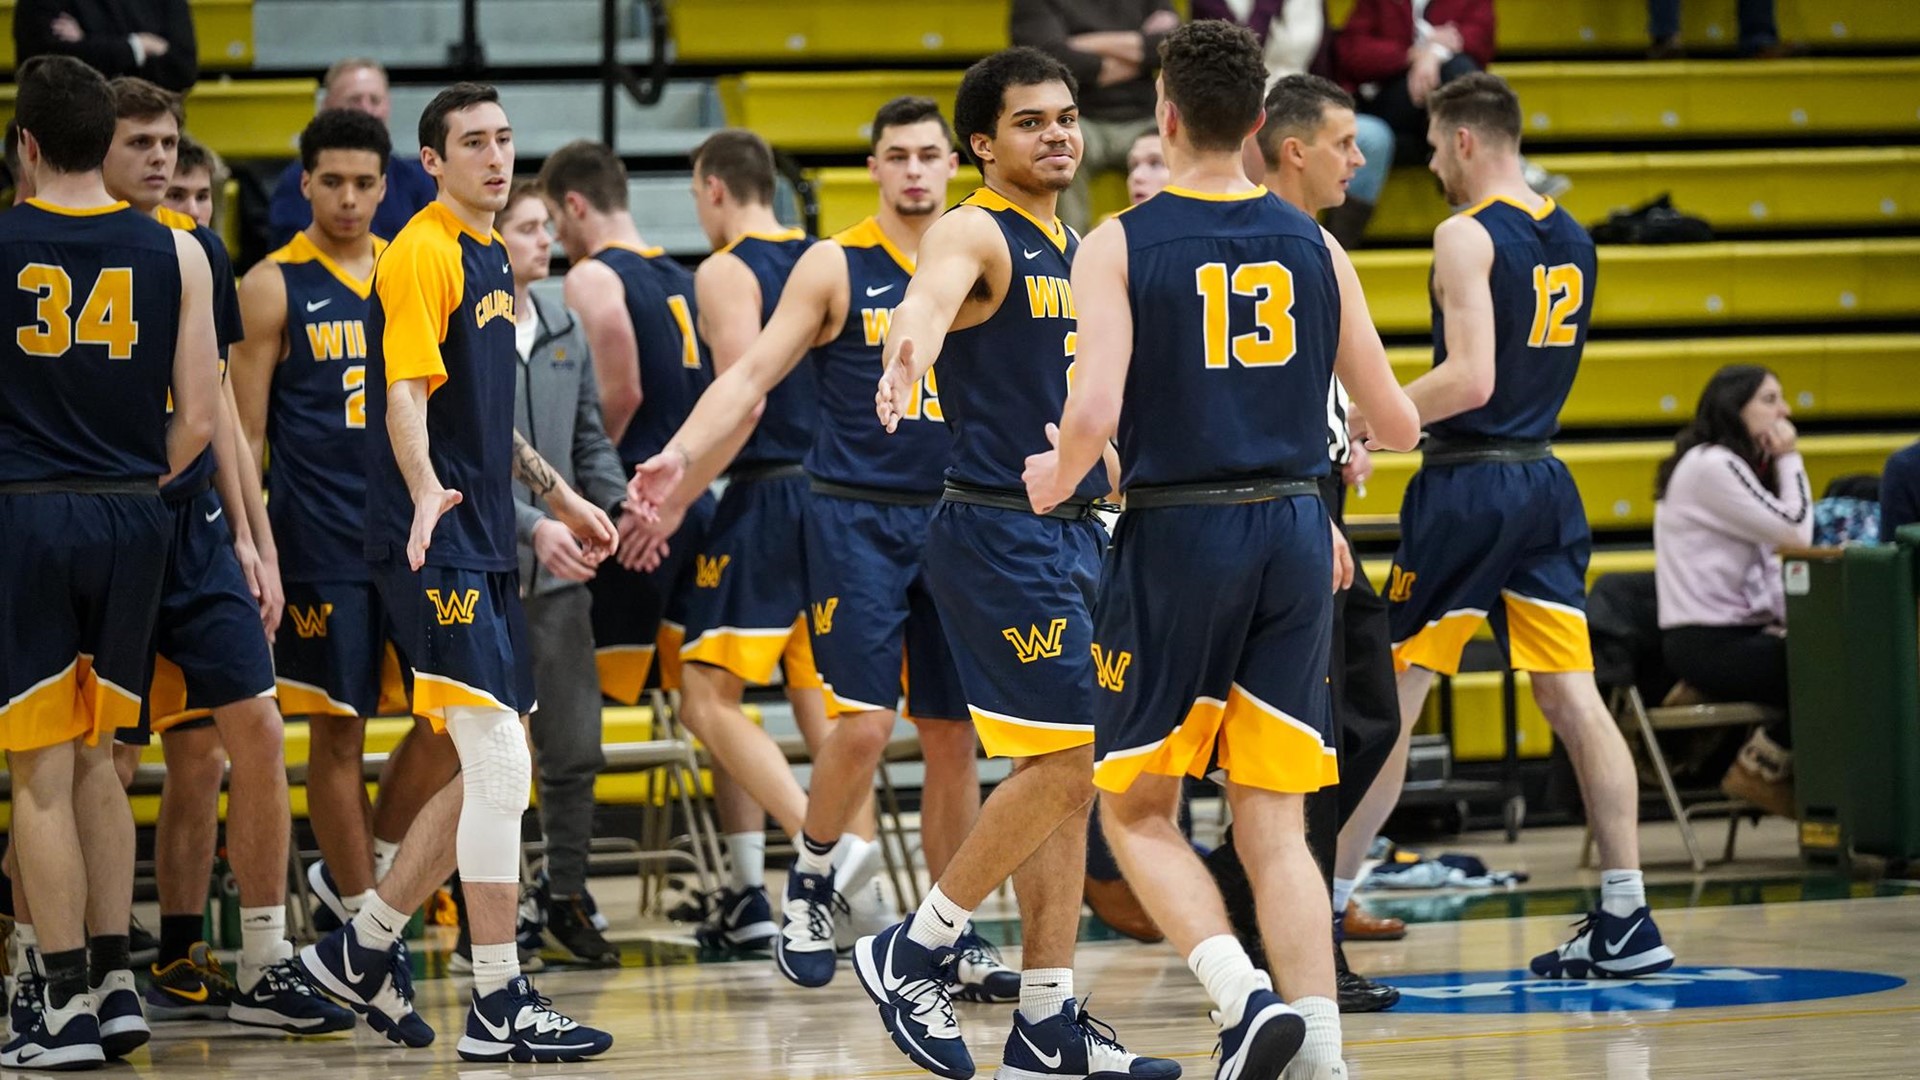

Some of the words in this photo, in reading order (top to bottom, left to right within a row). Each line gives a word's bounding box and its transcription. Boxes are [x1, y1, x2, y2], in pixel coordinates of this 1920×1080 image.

[17, 262, 138, 360] 34
[1195, 260, 1297, 369] 13
[1526, 262, 1584, 348] 12
[288, 603, 334, 638] W
[425, 588, 480, 626] W
[1001, 618, 1067, 664] W
[1090, 643, 1132, 693] W
